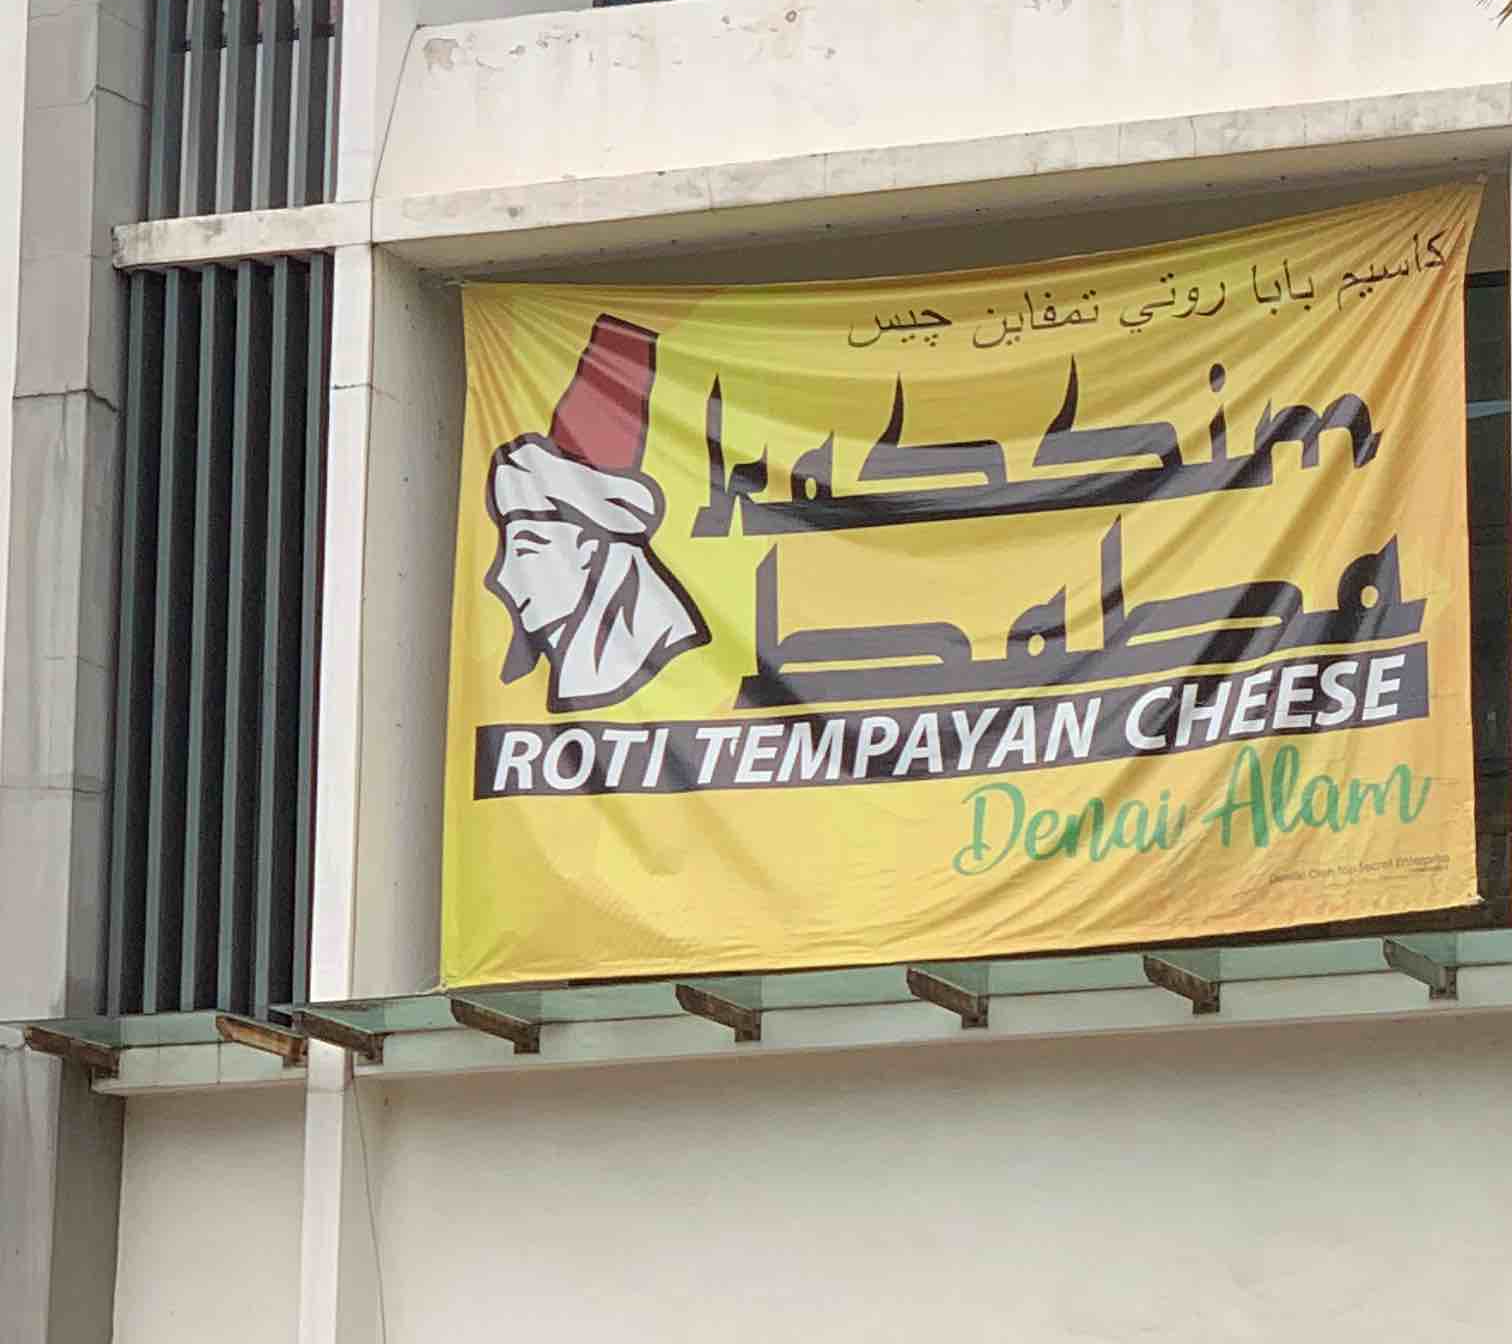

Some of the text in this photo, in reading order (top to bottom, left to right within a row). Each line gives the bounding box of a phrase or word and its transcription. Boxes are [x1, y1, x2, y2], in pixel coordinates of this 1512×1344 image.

[1120, 273, 1226, 333] روتي
[1252, 259, 1315, 315] بابا
[735, 513, 1426, 710] baba
[493, 654, 1407, 792] ROTI TEMPAYAN CHEESE
[952, 743, 1433, 876] Denai Alam
